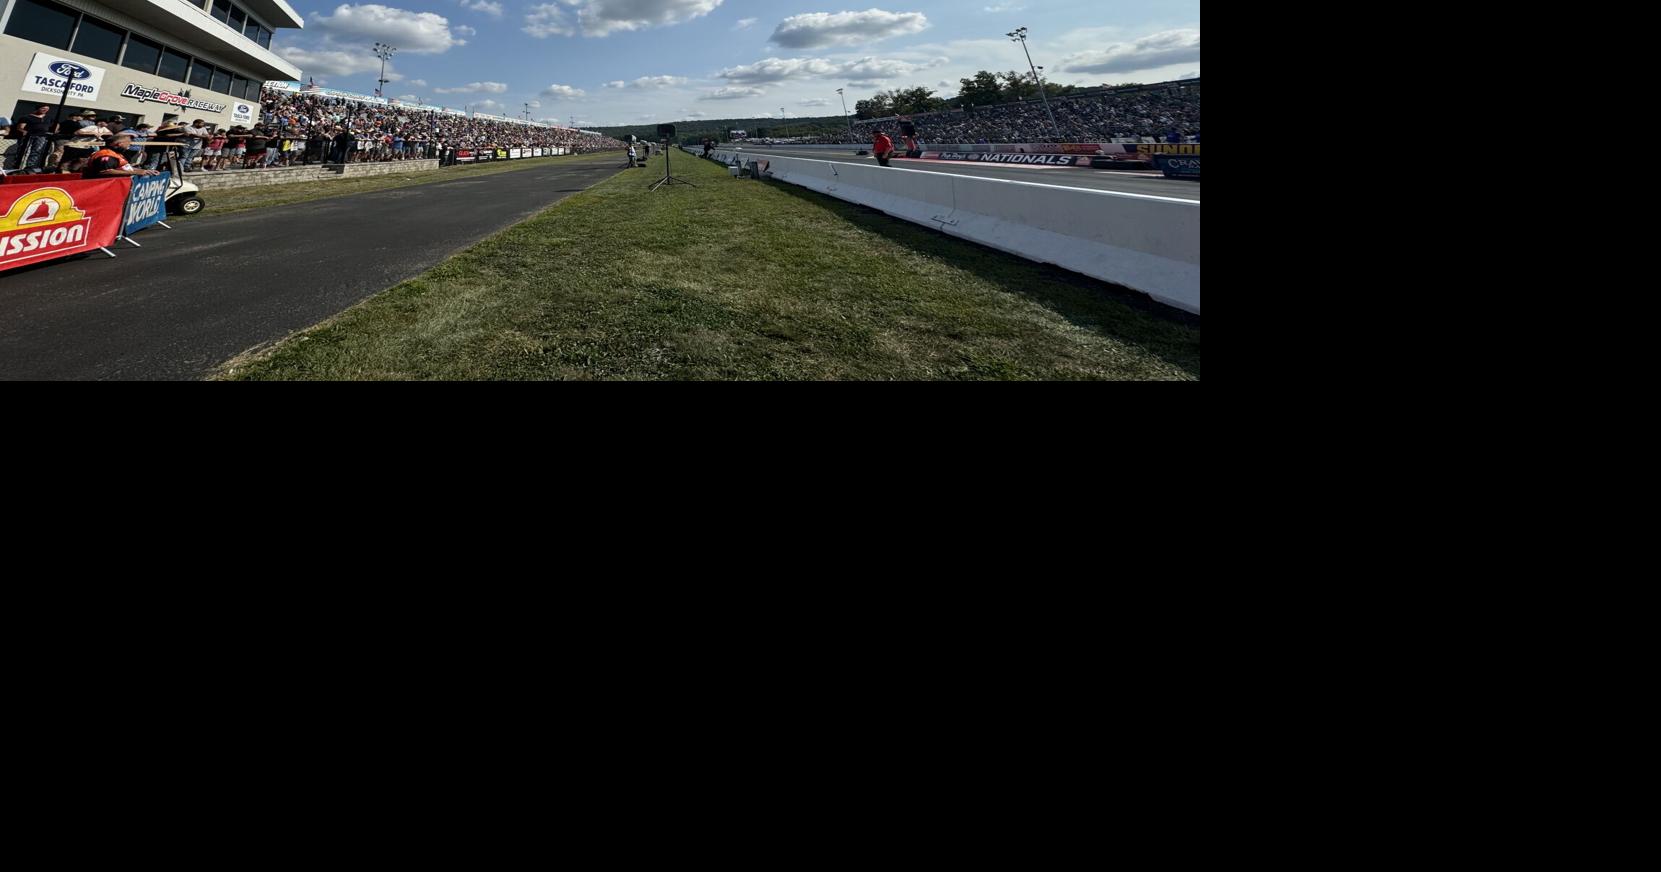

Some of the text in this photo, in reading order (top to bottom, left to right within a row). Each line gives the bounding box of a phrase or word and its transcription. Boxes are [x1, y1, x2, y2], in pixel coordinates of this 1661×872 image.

[35, 76, 94, 94] TASCA FORD
[980, 152, 1071, 165] NATIONALS
